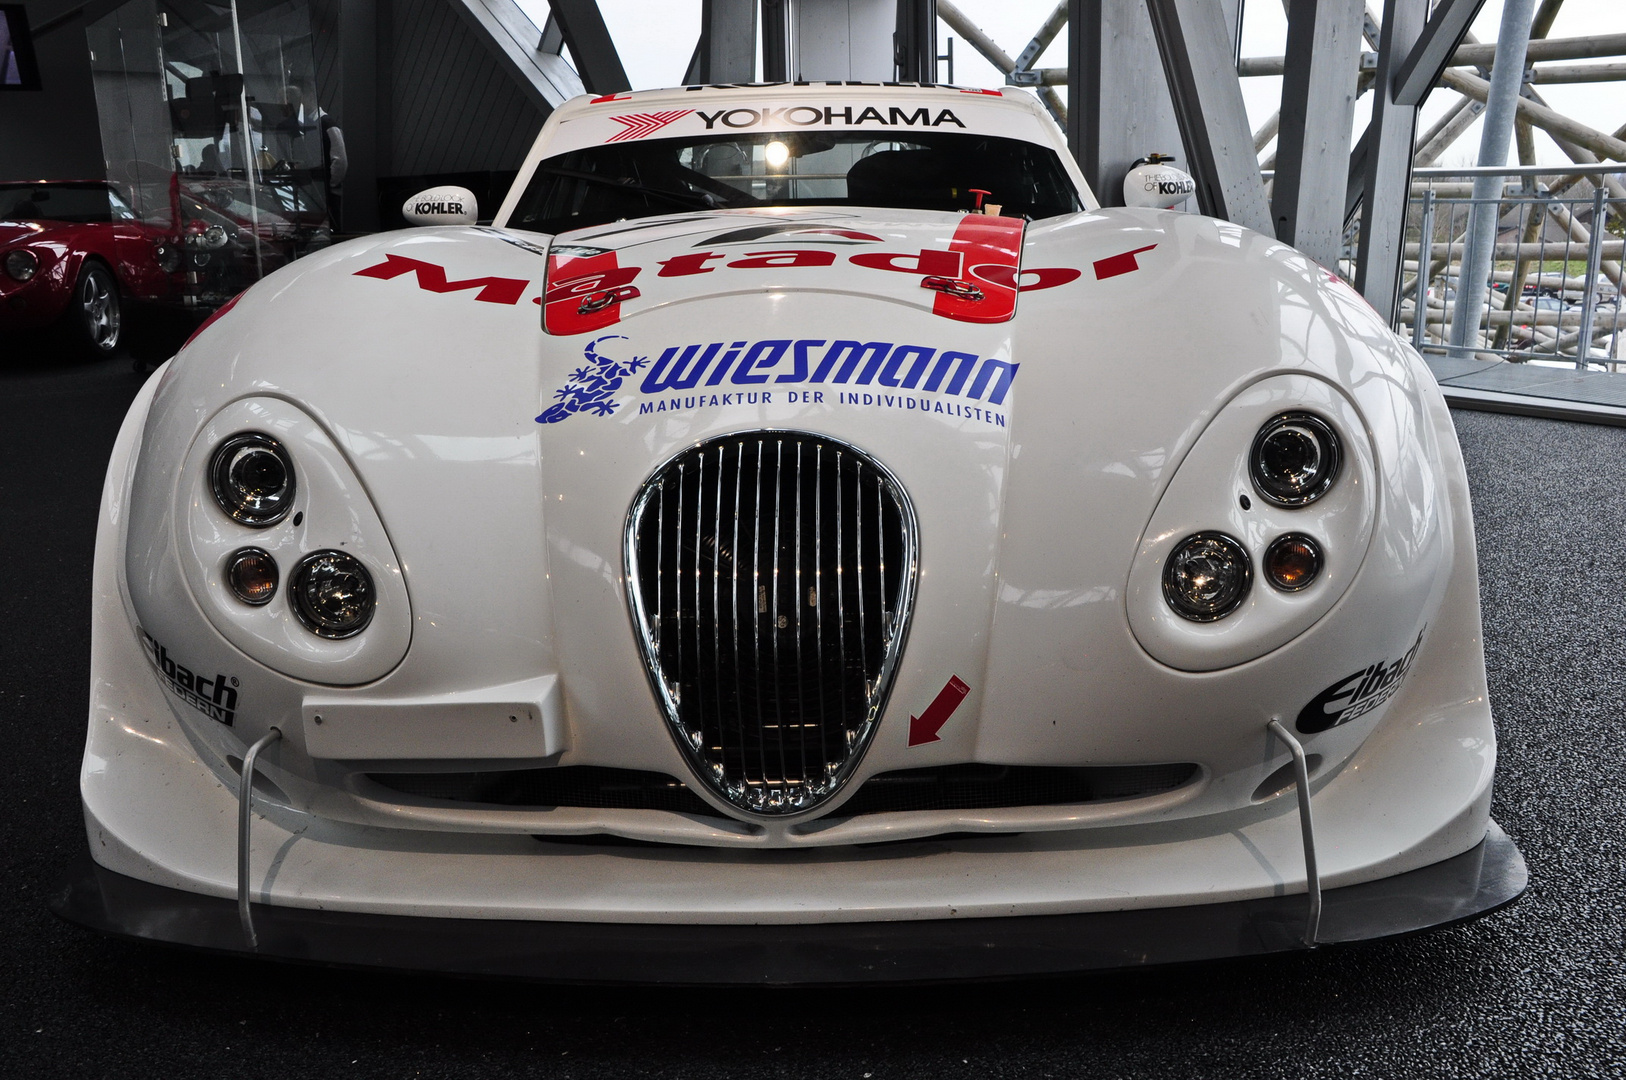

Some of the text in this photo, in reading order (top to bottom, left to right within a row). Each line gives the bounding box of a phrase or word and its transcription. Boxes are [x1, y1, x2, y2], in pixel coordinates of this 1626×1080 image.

[695, 106, 967, 130] YOKOHAMA
[352, 243, 1158, 305] Matador
[639, 391, 1006, 428] MANUFAKTUR DER INDIVIDUALISTEN
